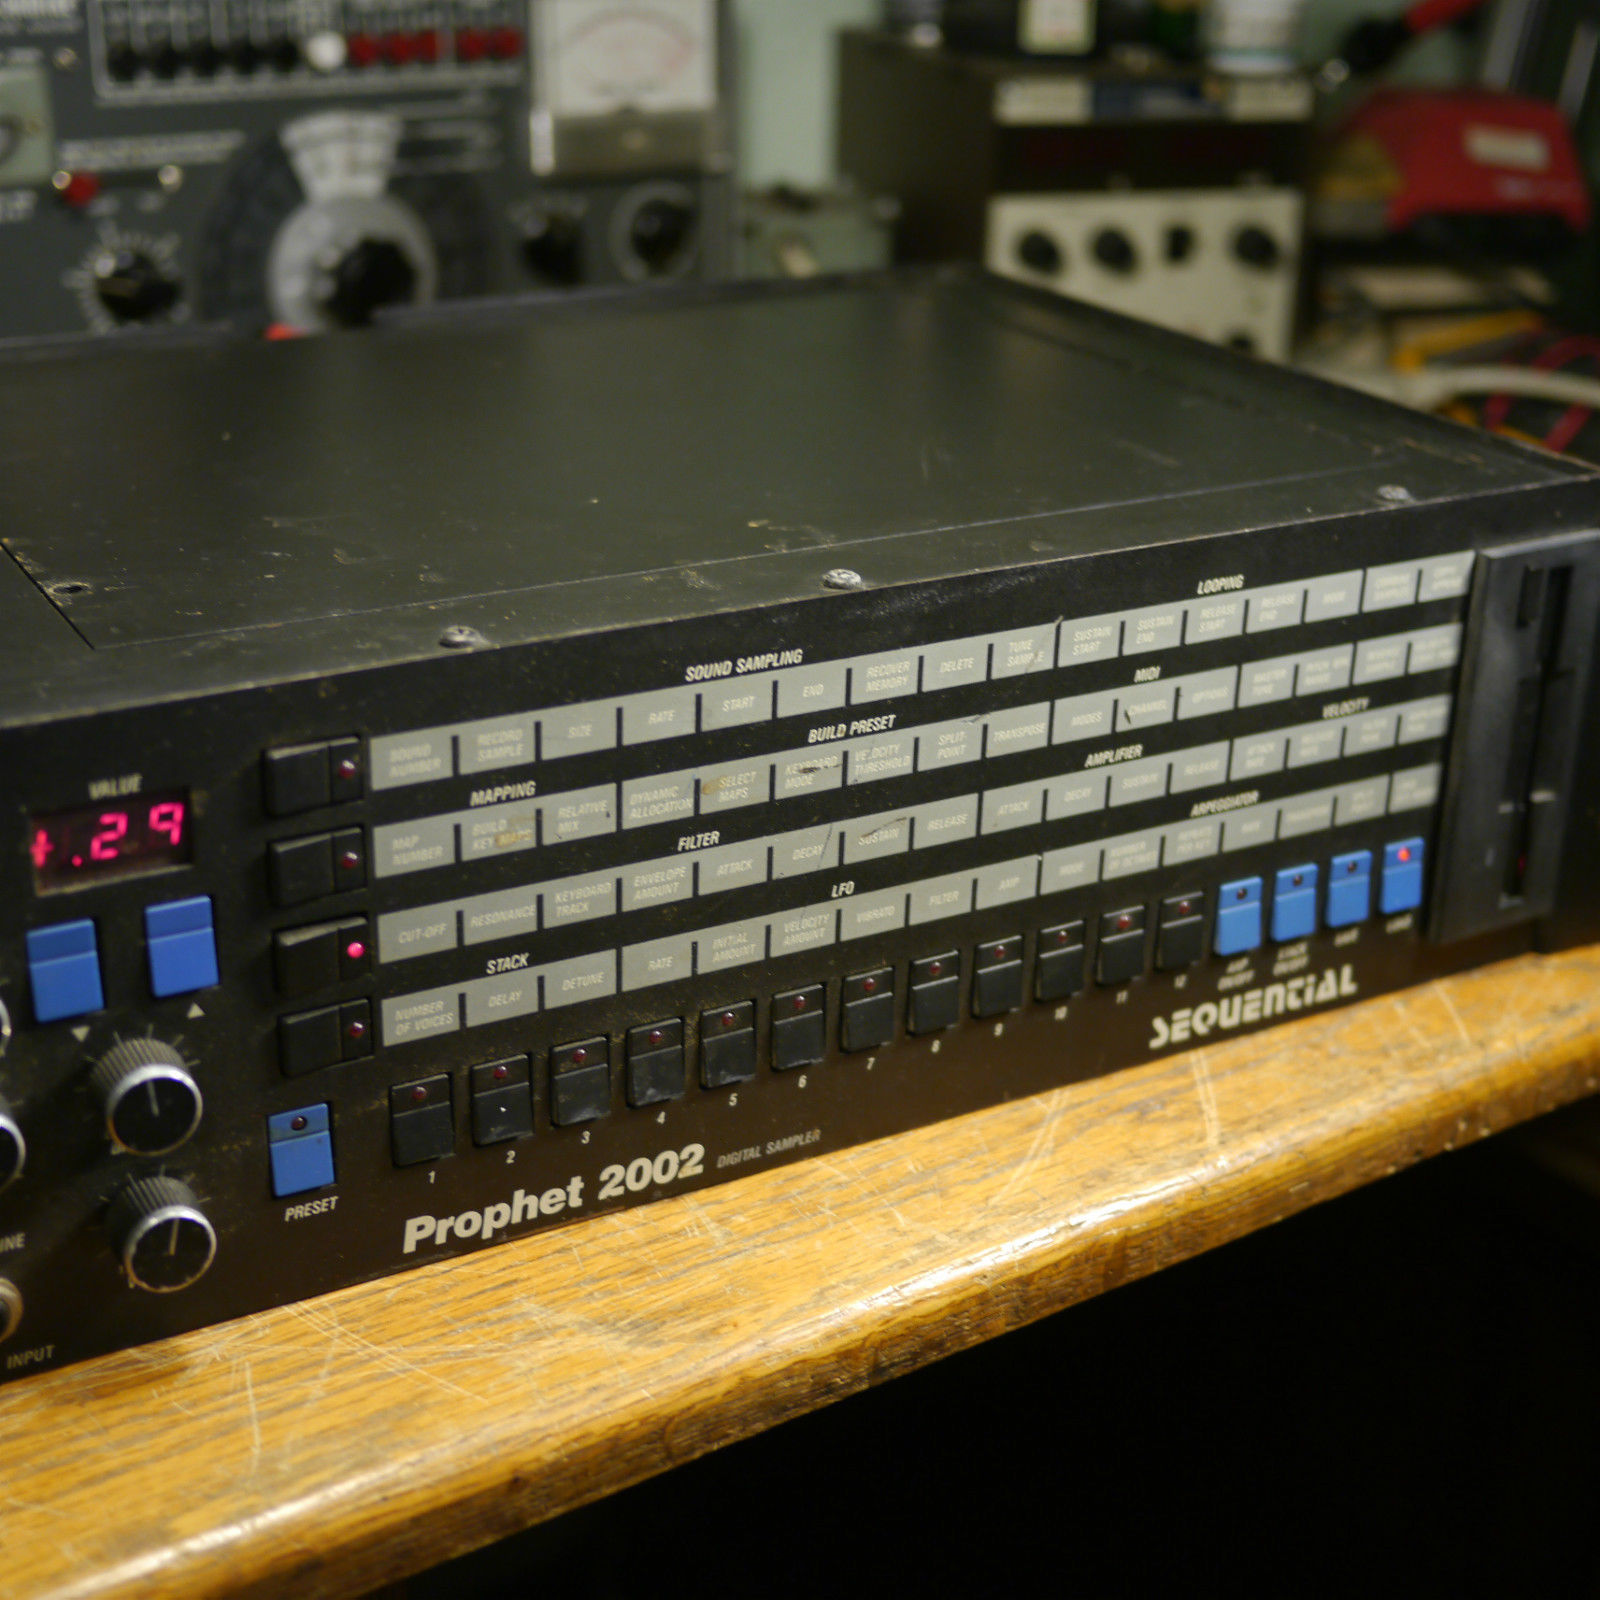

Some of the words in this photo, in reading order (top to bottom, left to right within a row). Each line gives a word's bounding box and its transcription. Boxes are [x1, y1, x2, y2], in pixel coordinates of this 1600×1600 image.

[685, 660, 732, 682] SOUND
[736, 648, 804, 674] SAMPLING
[940, 657, 975, 674] DELETE
[802, 683, 824, 698] END
[722, 696, 756, 712] START
[648, 709, 676, 724] RATE
[567, 724, 592, 739] SIZE
[808, 721, 846, 744] BUILD
[850, 714, 896, 736] PRESET
[1084, 744, 1143, 768] AMPLIFIER
[88, 773, 143, 800] VALUE
[470, 780, 536, 806] MAPPING
[629, 798, 694, 819] ALLOCATION
[678, 830, 720, 852] FILTER
[554, 882, 612, 904] KEYBOARD
[832, 881, 856, 898] LFO
[470, 904, 536, 928] RESONANCE
[555, 902, 590, 918] TRACK
[398, 923, 448, 944] CUT-OFF
[486, 952, 530, 975] STACK
[648, 956, 673, 972] RATE
[562, 972, 604, 990] DETUNE
[488, 990, 523, 1008] DELAY
[931, 1038, 942, 1054] 8
[866, 1056, 876, 1071] 7
[798, 1074, 808, 1089] 6
[728, 1093, 738, 1107] 5
[656, 1111, 666, 1125] 4
[580, 1131, 591, 1144] 3
[506, 1150, 516, 1164] 2
[428, 1170, 436, 1184] 1
[403, 1175, 585, 1254] Prophet
[598, 1143, 705, 1201] 2002
[716, 1146, 762, 1170] DIGITAL
[765, 1128, 821, 1155] SAMPLER
[285, 1196, 339, 1222] PRESET
[7, 1344, 55, 1370] INPUT
